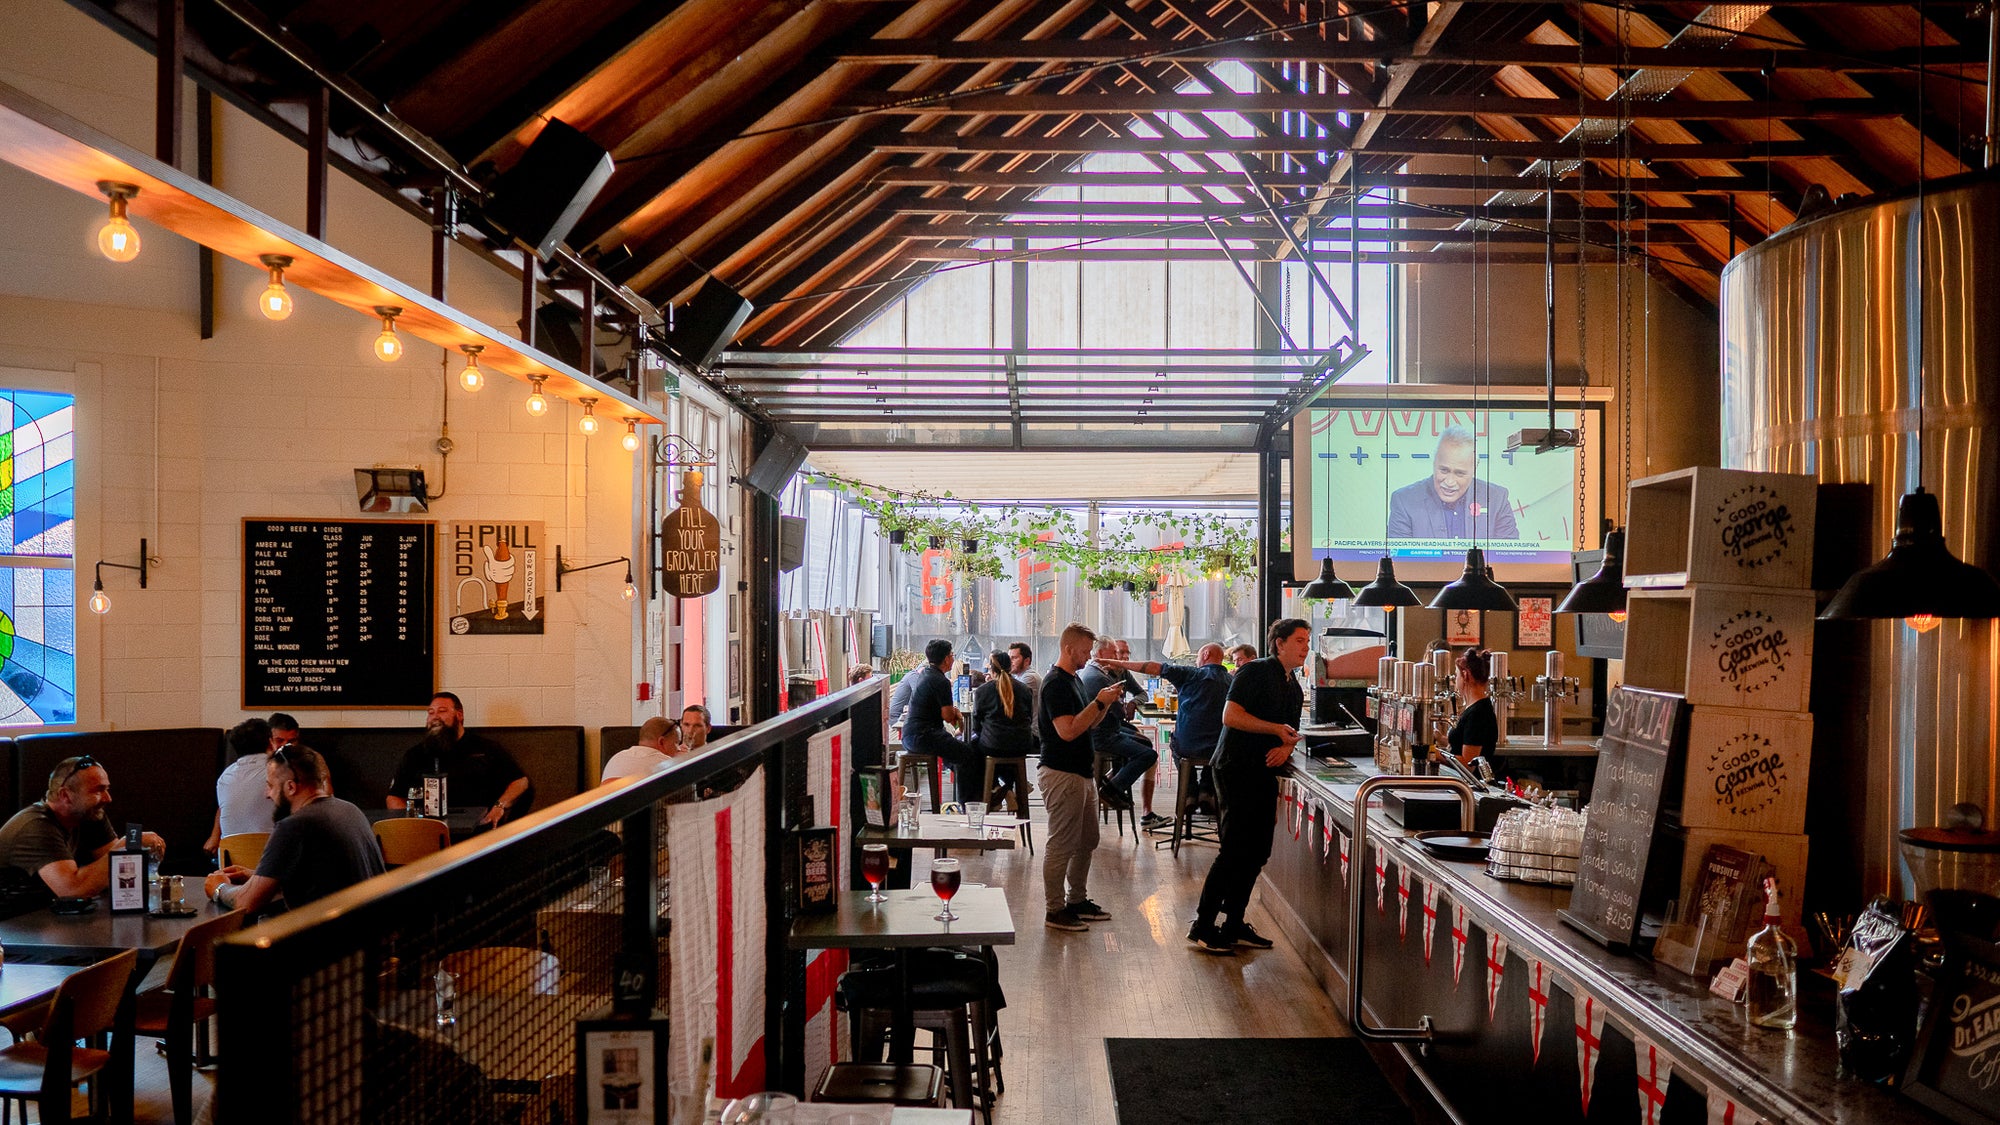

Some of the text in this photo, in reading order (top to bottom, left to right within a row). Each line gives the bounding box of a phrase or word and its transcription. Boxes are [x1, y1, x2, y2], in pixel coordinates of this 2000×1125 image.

[680, 507, 706, 528] FILL
[1728, 500, 1766, 522] GOOD
[479, 525, 536, 548] PULL
[678, 529, 704, 550] YOUR
[1722, 505, 1792, 556] George
[666, 550, 718, 572] GROWLER
[680, 574, 704, 594] HERE
[1726, 626, 1763, 648] GOOD
[1718, 630, 1788, 682] George
[1606, 688, 1670, 746] SPECIAL
[1722, 748, 1760, 770] GOOD
[1600, 751, 1658, 792] Traditional
[1715, 753, 1784, 804] George
[1592, 788, 1628, 820] Cornish
[1582, 846, 1609, 876] Garden
[1708, 862, 1734, 878] PURSUIT
[1584, 872, 1610, 900] tomato
[619, 970, 644, 993] 40
